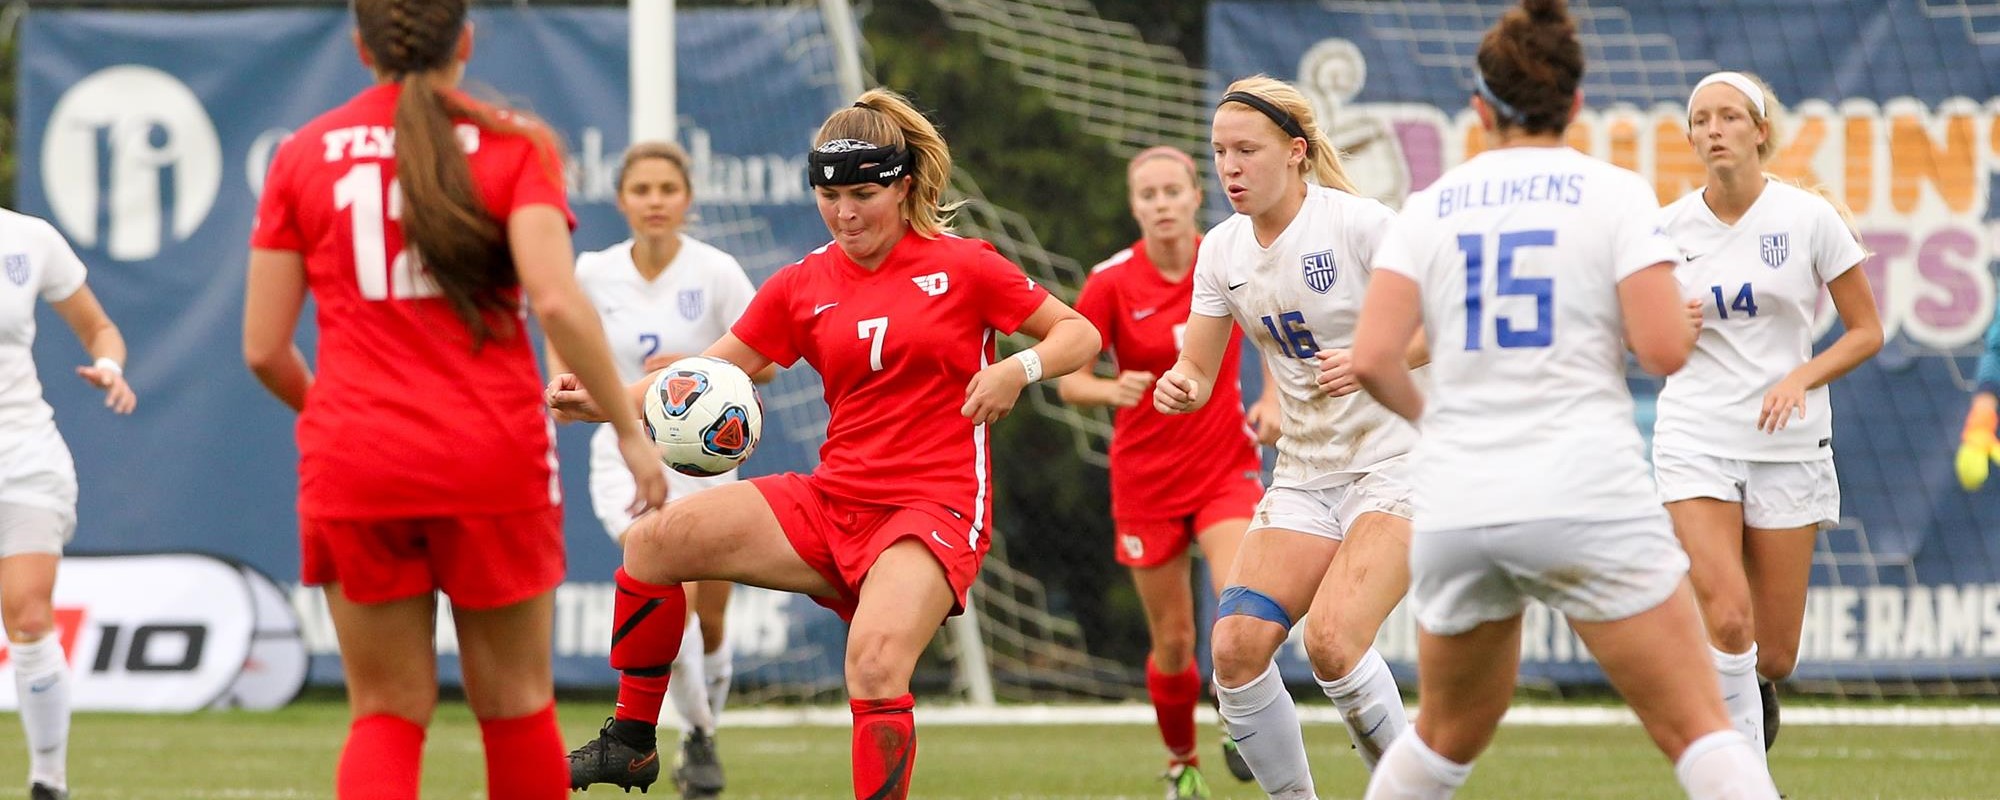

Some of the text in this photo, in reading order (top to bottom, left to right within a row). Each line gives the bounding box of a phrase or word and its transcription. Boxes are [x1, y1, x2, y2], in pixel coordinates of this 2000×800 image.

[1438, 173, 1584, 218] BILLIKENS
[1304, 252, 1332, 274] SLU
[1763, 235, 1786, 250] SLU
[1457, 229, 1556, 350] 15
[1711, 282, 1758, 319] 14
[639, 332, 660, 365] 2
[857, 316, 889, 372] 7
[1261, 311, 1320, 359] 16
[1800, 587, 1858, 660] HE
